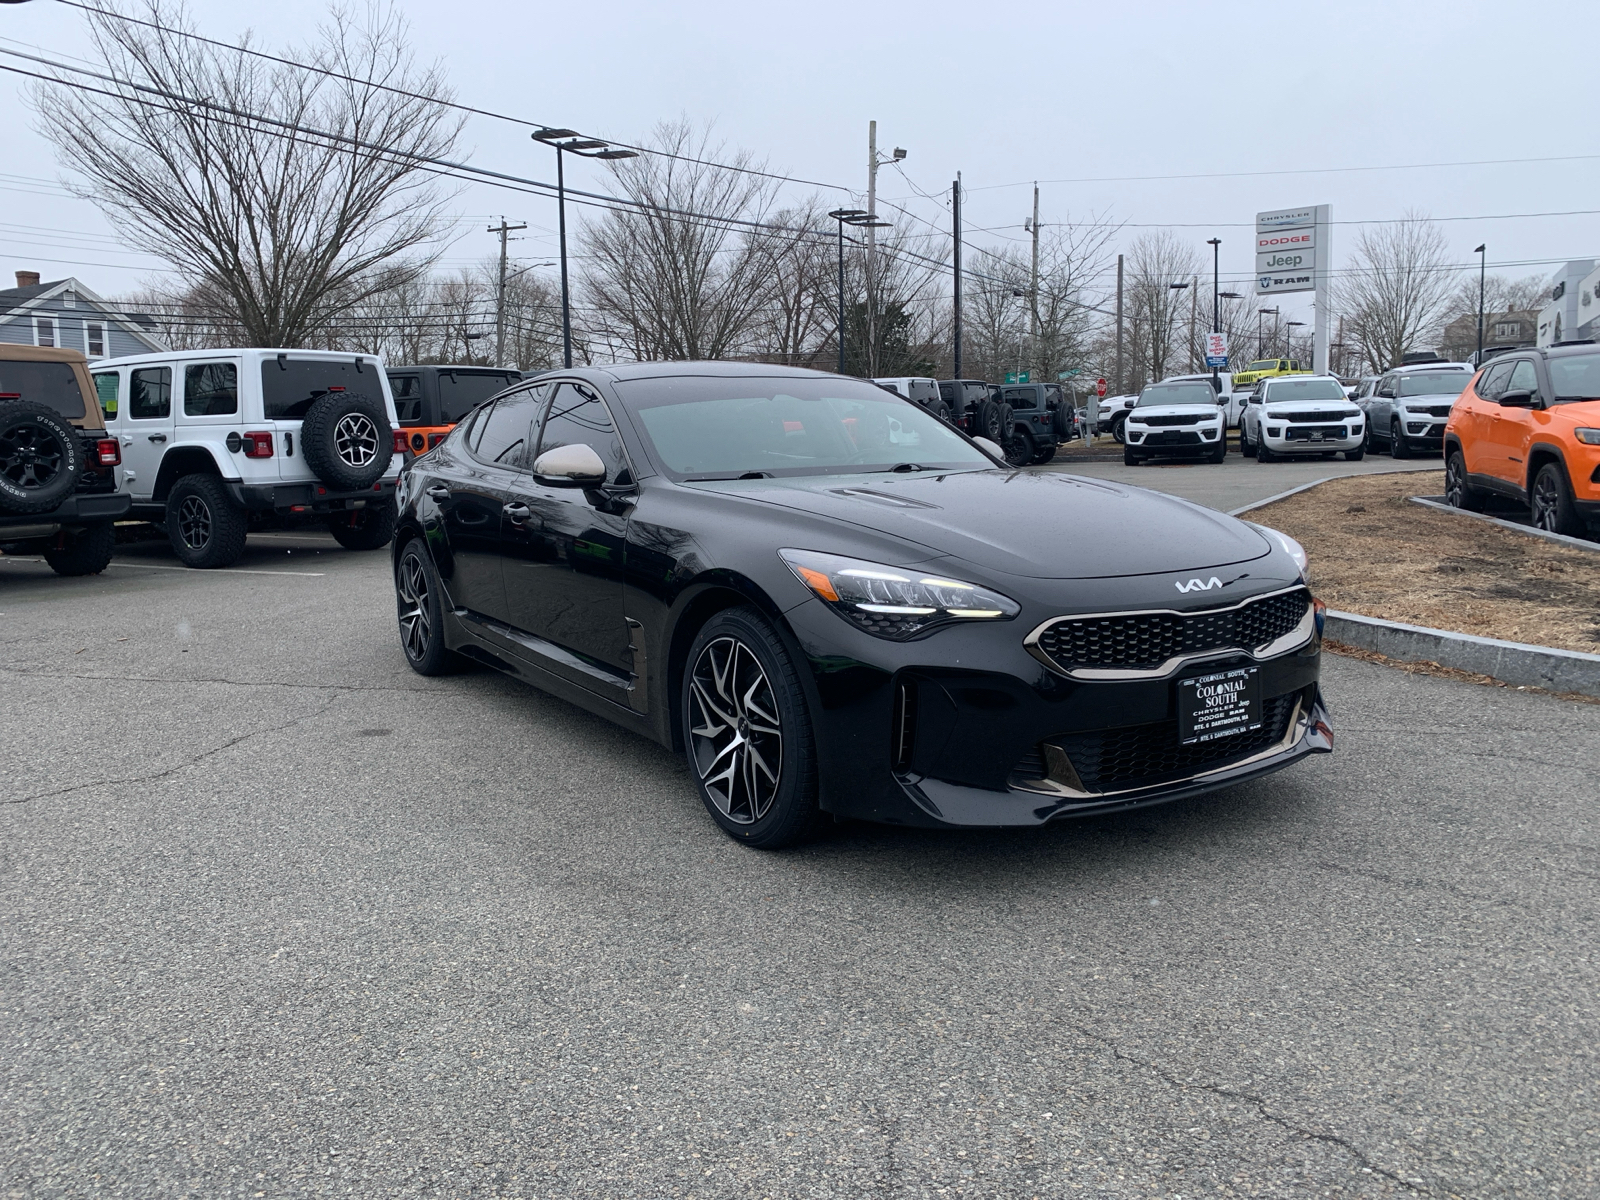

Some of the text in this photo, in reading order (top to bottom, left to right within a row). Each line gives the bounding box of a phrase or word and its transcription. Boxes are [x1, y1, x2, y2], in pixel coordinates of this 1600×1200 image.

[1261, 213, 1310, 221] CHRYSLER
[1259, 235, 1310, 246] DODGE
[1266, 255, 1302, 267] Jeep
[1274, 276, 1310, 285] RAM
[1097, 383, 1106, 391] STOP
[1175, 577, 1223, 593] KIA
[1199, 674, 1225, 684] COLONIAL
[1227, 670, 1245, 678] SOUTH
[1196, 680, 1246, 699] COLONIAL
[1205, 692, 1238, 707] SOUTH
[1193, 704, 1234, 716] CHRYSLER
[1198, 712, 1225, 722] DODGE
